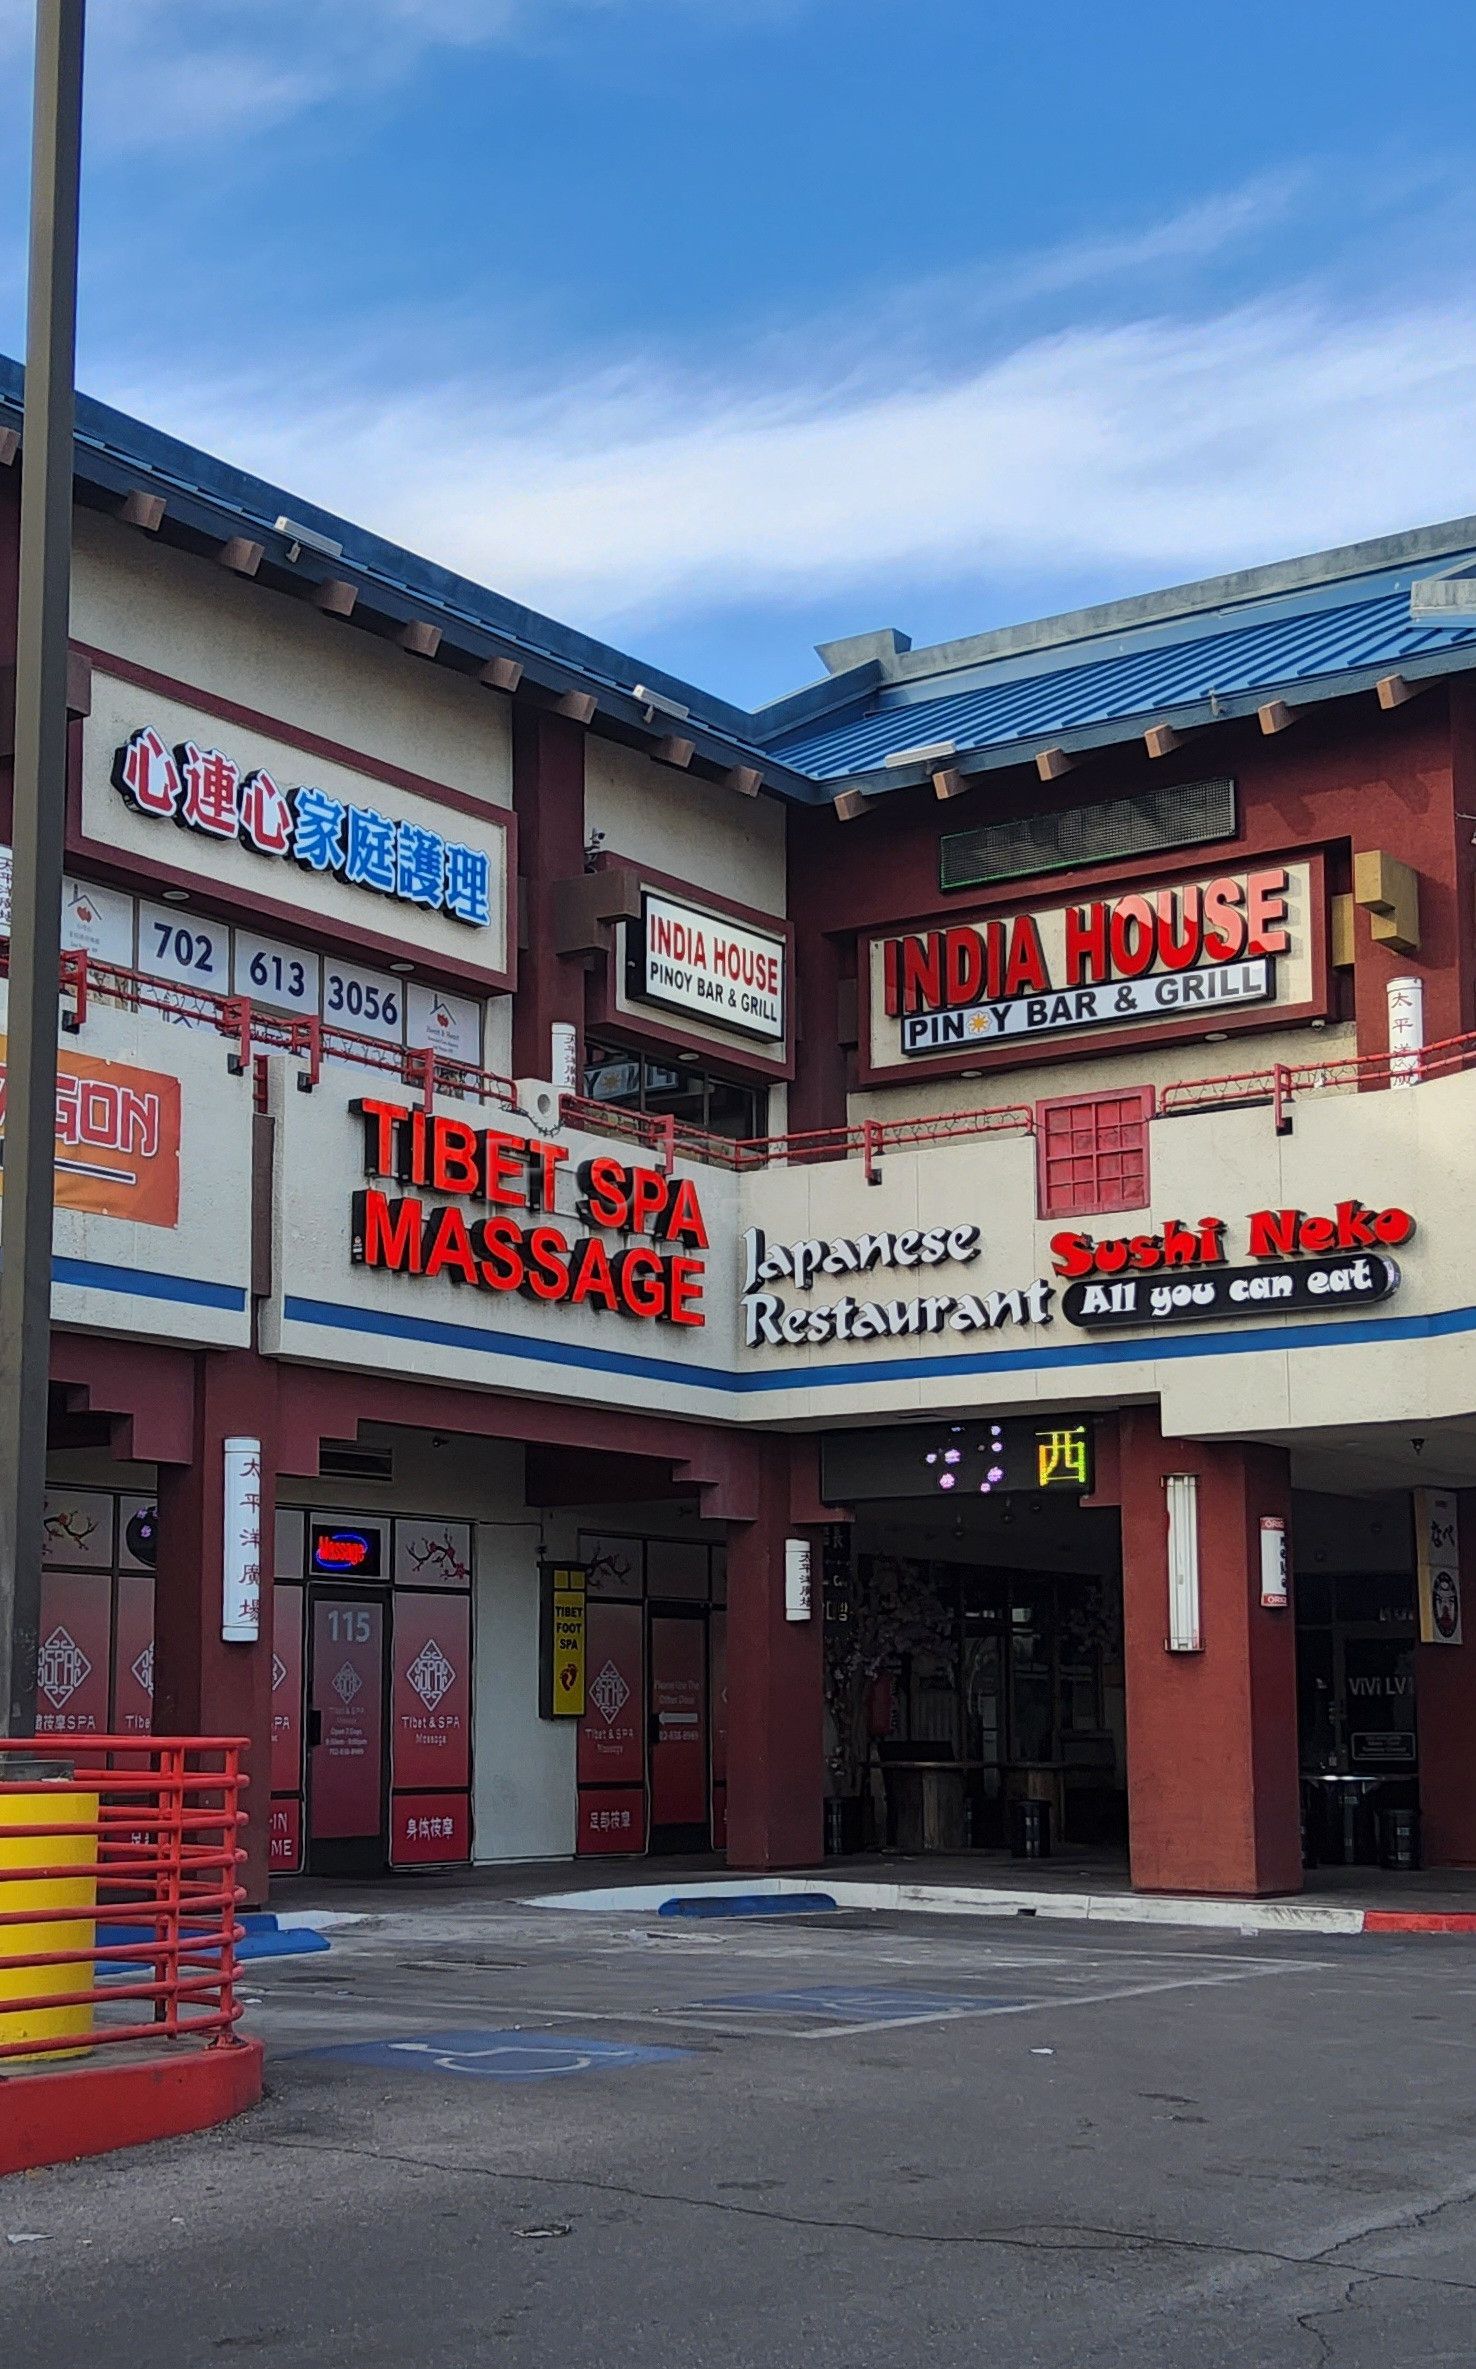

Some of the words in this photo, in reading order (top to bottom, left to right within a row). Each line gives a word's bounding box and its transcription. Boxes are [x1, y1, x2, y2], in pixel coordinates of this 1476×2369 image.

[116, 725, 492, 929] 心連心家庭護理
[154, 923, 214, 972] 702
[249, 949, 306, 998] 613
[327, 976, 399, 1026] 3056
[650, 914, 707, 971] INDIA
[713, 937, 779, 996] HOUSE
[884, 914, 1049, 1017] INDIA
[1066, 869, 1291, 986] HOUSE
[650, 961, 693, 993] PINOY
[697, 977, 724, 1004] BAR
[728, 988, 737, 1008] &
[741, 993, 778, 1022] GRILL
[1027, 991, 1098, 1028] BAR
[1114, 985, 1138, 1013] &
[1154, 966, 1263, 1007] GRILL
[356, 1097, 569, 1214] TIBET
[581, 1156, 710, 1249] SPA
[355, 1187, 706, 1327] MASSAGE
[742, 1224, 981, 1294] Japanese
[1050, 1217, 1228, 1278] Sushi
[1247, 1200, 1416, 1258] Neko
[741, 1278, 1055, 1348] Restaurant
[1079, 1282, 1137, 1315] All
[1150, 1282, 1215, 1316] you
[1229, 1274, 1292, 1301] can
[1307, 1259, 1374, 1294] eat
[1035, 1424, 1087, 1488] 西
[318, 1536, 366, 1566] Massage
[328, 1610, 371, 1643] 115
[555, 1606, 583, 1618] TIBET
[556, 1623, 581, 1634] FOOT
[559, 1639, 578, 1651] SPA
[438, 1716, 460, 1729] SPA
